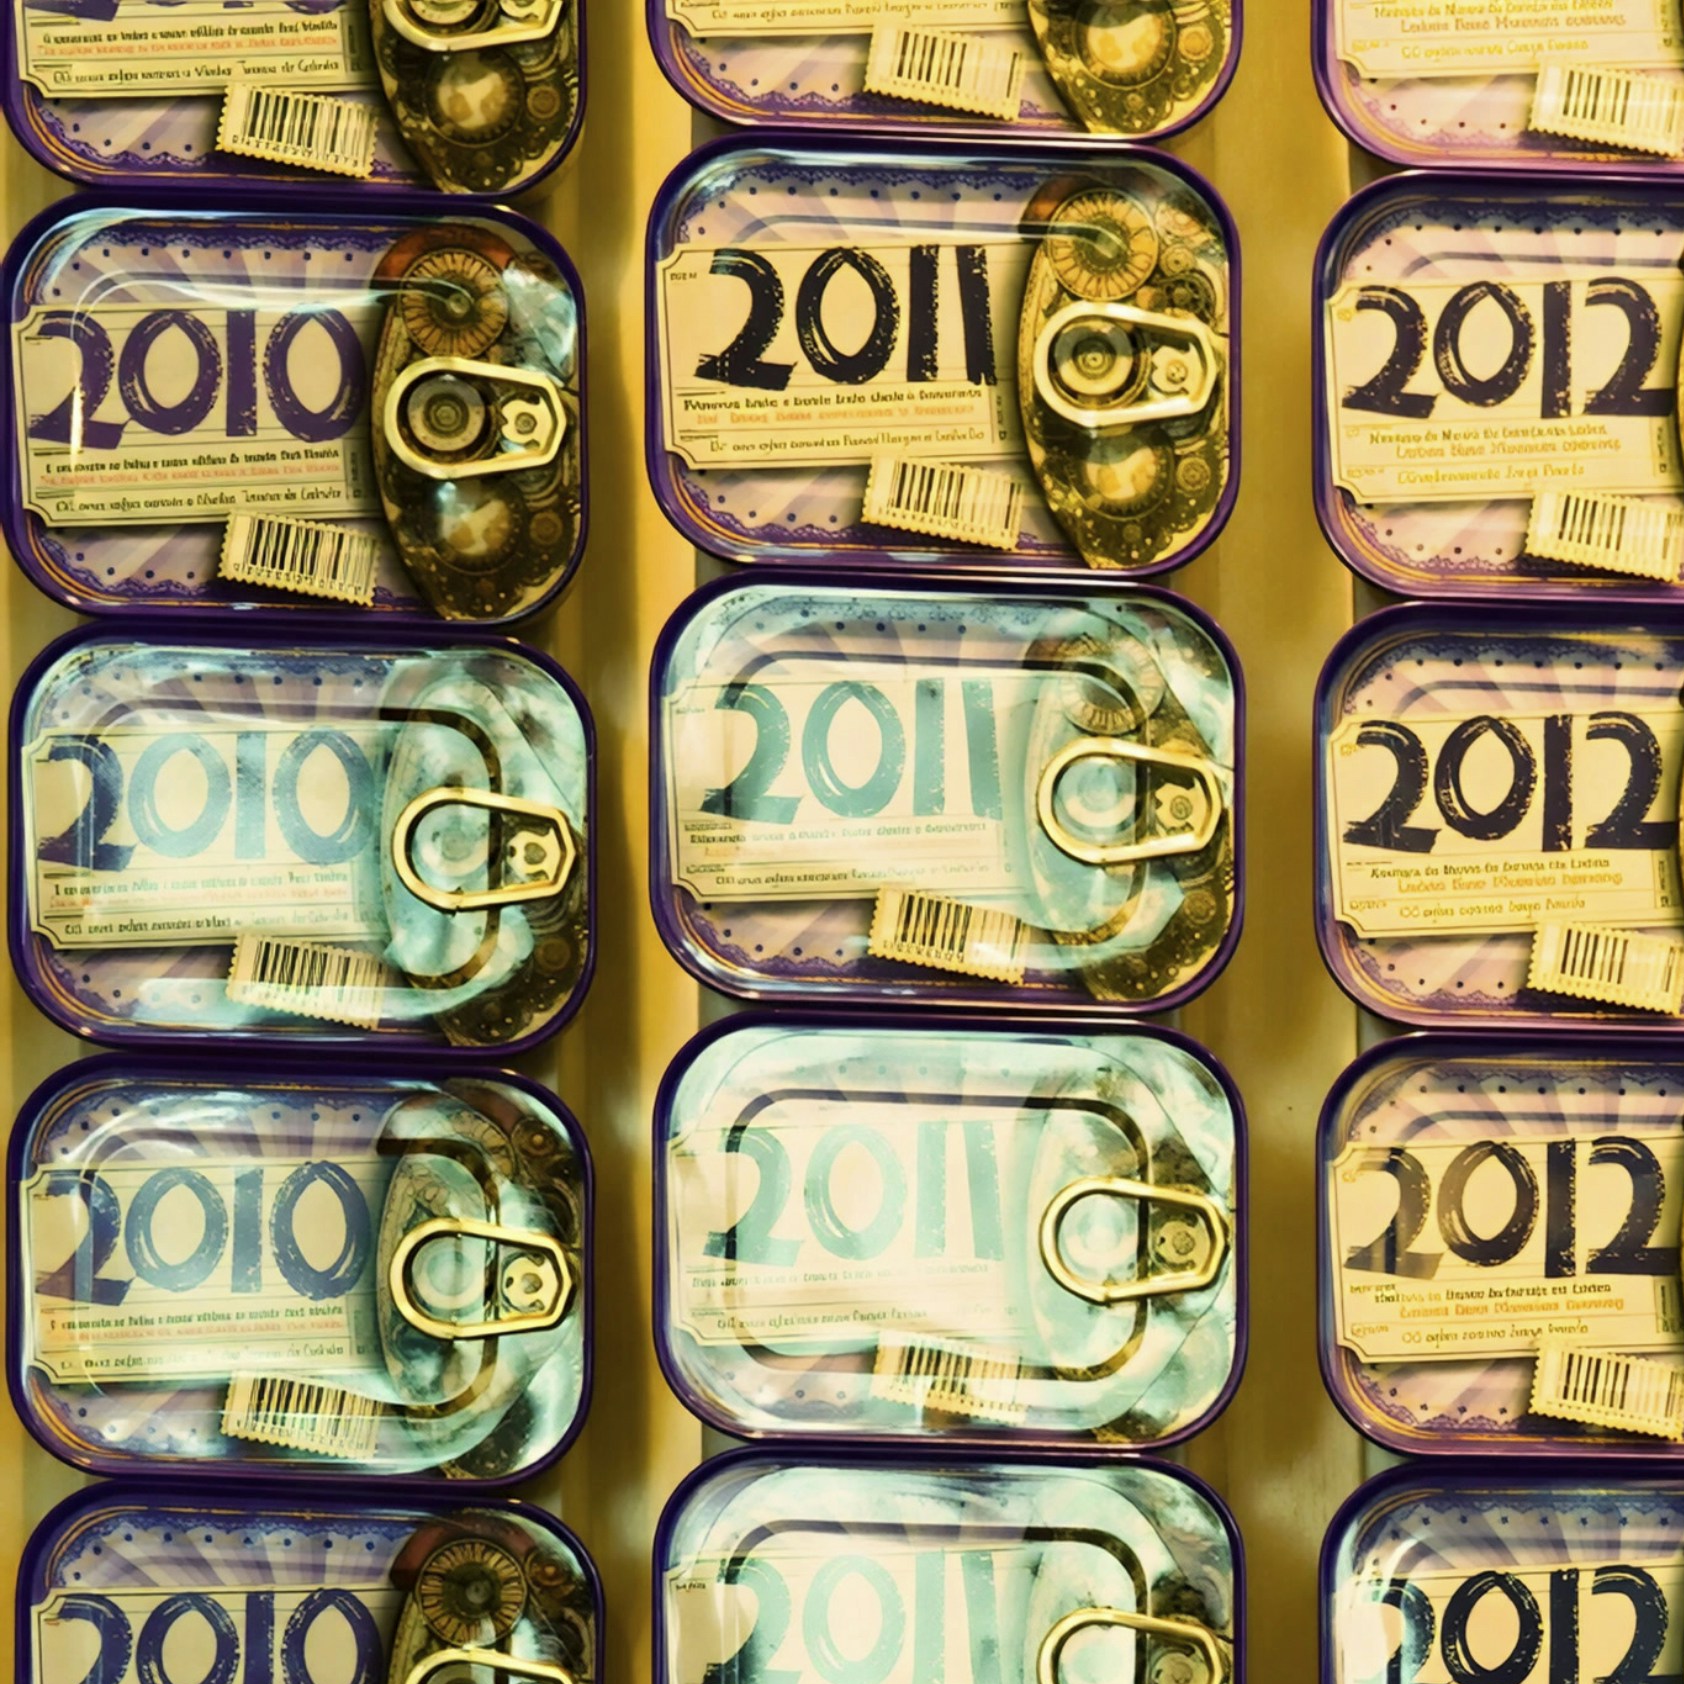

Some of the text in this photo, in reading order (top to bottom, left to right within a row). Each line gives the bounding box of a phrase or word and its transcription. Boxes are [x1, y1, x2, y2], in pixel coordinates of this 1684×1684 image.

[30, 308, 365, 450] 2010
[696, 246, 1000, 390] 2011
[1343, 279, 1678, 419] 2012
[33, 727, 373, 869] 2010
[701, 679, 1001, 824] 2011
[1345, 712, 1681, 852] 2012
[35, 1161, 370, 1306] 2010
[707, 1119, 1001, 1263] 2011
[1347, 1137, 1680, 1278] 2012
